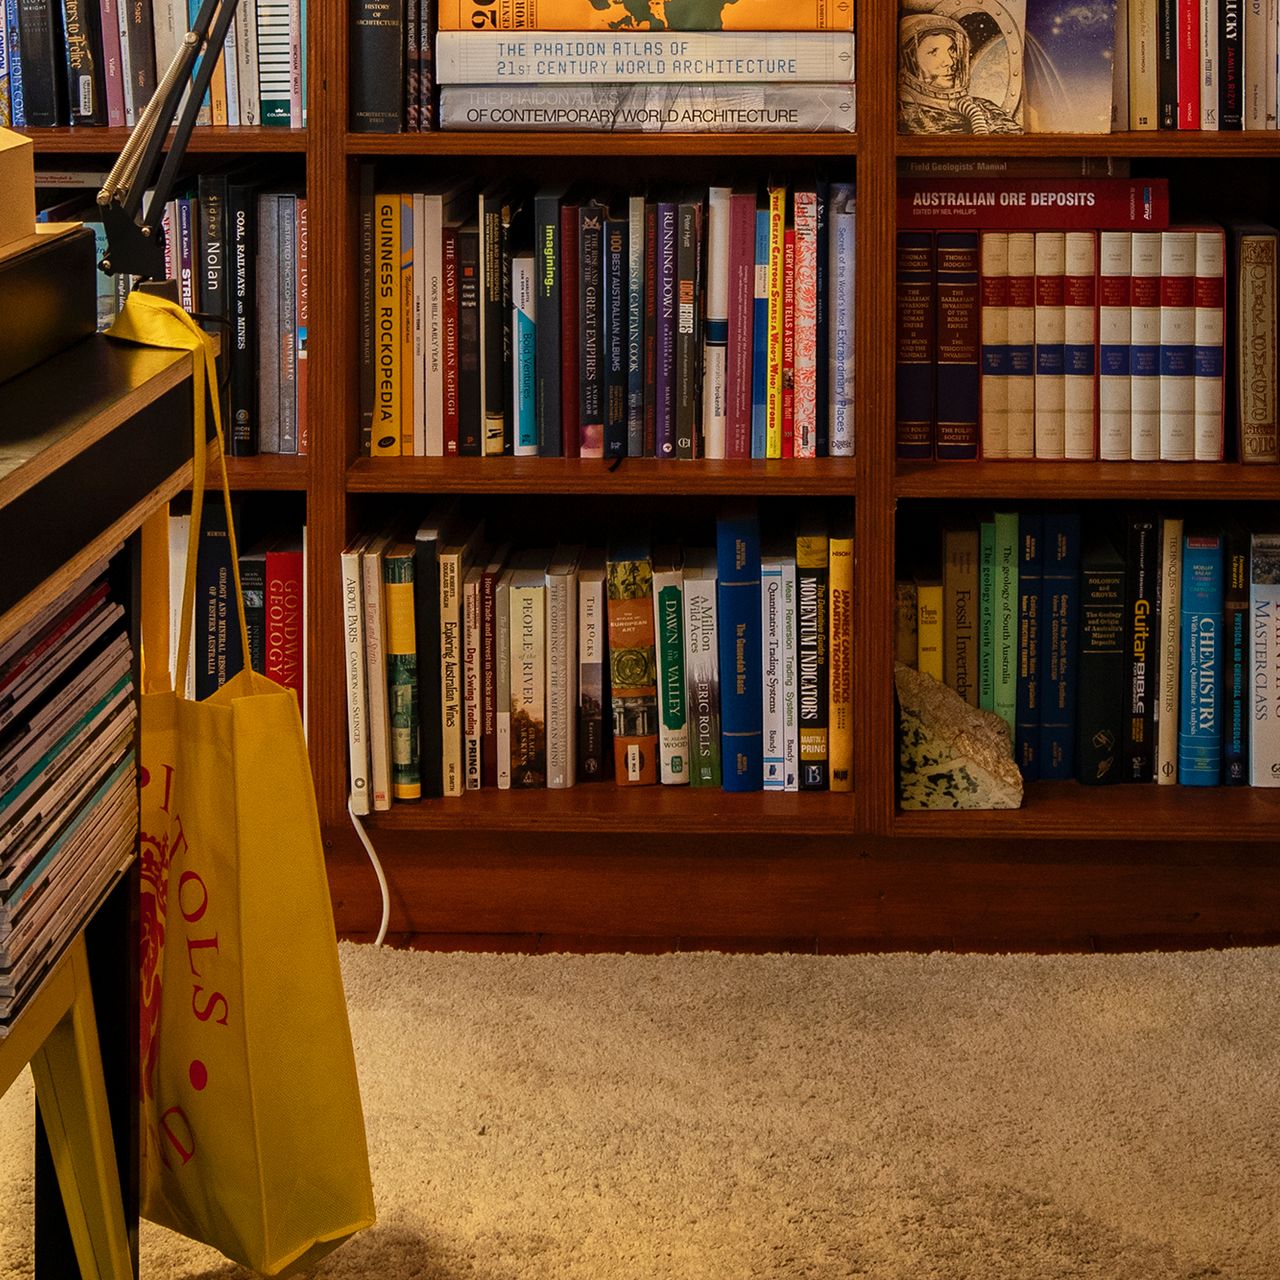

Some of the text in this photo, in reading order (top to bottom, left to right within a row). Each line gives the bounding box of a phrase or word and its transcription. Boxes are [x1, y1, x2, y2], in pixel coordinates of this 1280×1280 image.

[498, 42, 689, 56] THE PHAIDON ATLAS OF
[537, 61, 608, 75] CENTURY
[615, 60, 666, 74] WORLD
[673, 59, 797, 74] ARCHITECTURE
[467, 108, 798, 122] OF CONTEMPORARY WORLD ARCHITECTURE
[913, 192, 1095, 208] AUSTRALIAN ORE DEPOSITS
[207, 242, 221, 290] Nolan
[661, 211, 674, 318] RUNNING DOWN
[380, 205, 395, 422] GUINNESS ROCKOPEDIA
[269, 580, 283, 674] GEOLOGY
[799, 577, 818, 719] MOMENTUM INDICATORS
[1132, 599, 1150, 662] Guitar
[1255, 600, 1270, 720] MASTERCLASS
[443, 622, 458, 727] Exploring Australian Wines
[1196, 617, 1214, 732] CHEMISTRY
[698, 683, 711, 756] ERIC ROLLS
